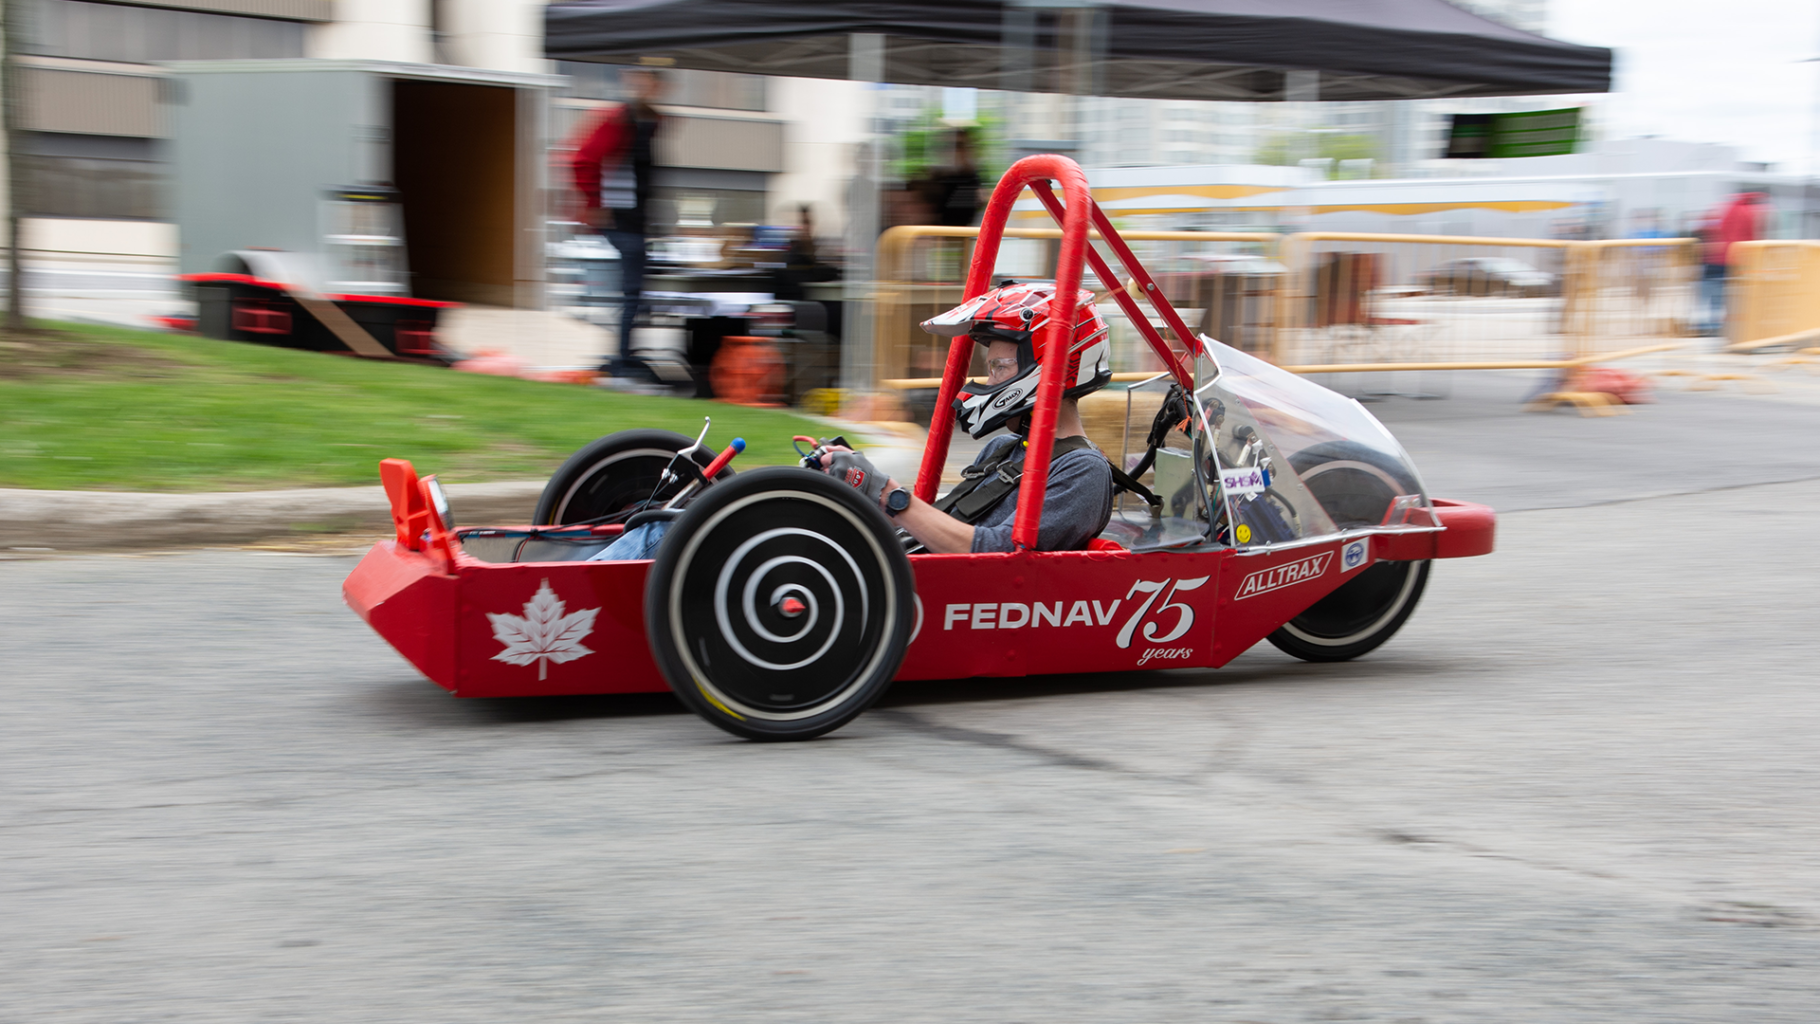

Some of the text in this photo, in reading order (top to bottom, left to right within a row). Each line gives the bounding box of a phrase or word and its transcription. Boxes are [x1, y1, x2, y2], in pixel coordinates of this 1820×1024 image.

[1243, 556, 1323, 595] ALLTRAX
[943, 575, 1211, 649] FEDNAV 75
[1136, 648, 1194, 666] years
